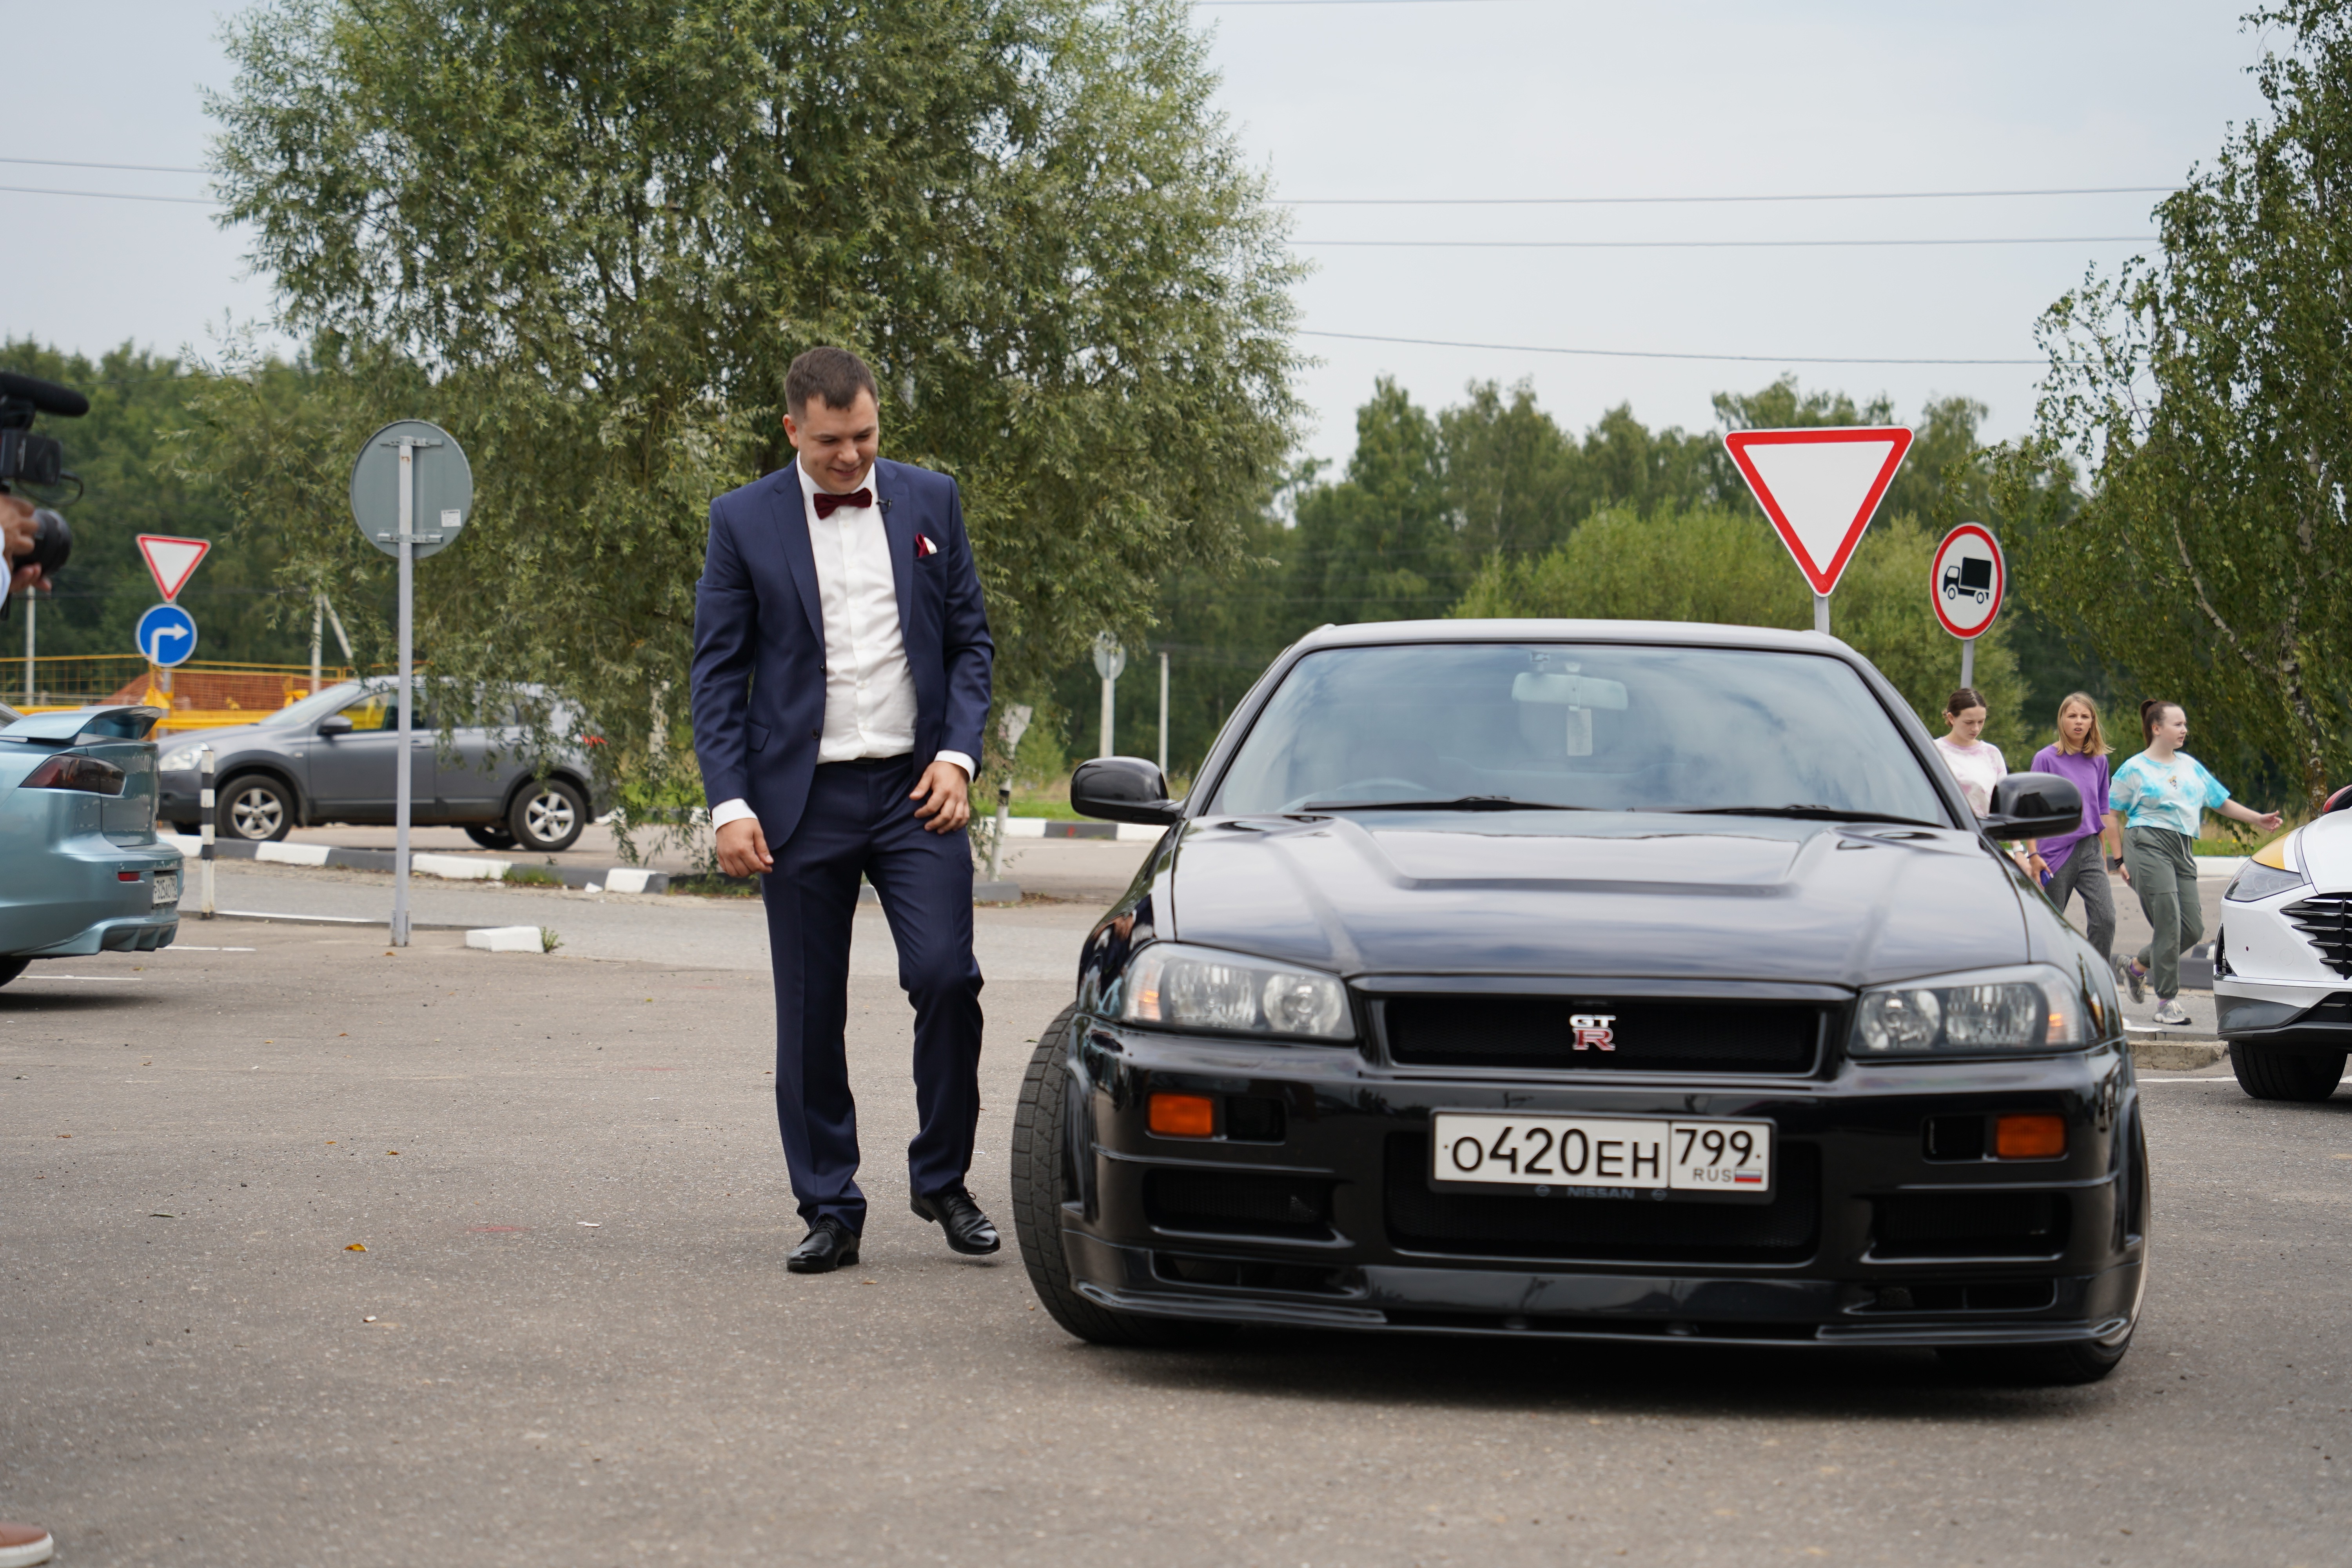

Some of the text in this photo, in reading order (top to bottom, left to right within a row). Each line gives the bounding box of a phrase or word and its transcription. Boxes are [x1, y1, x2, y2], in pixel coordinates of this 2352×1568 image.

[1569, 1014, 1617, 1028] GT
[1572, 1027, 1616, 1051] R
[1675, 1129, 1753, 1167] 799
[1693, 1167, 1731, 1182] RUS
[1567, 1186, 1635, 1199] NISSAN
